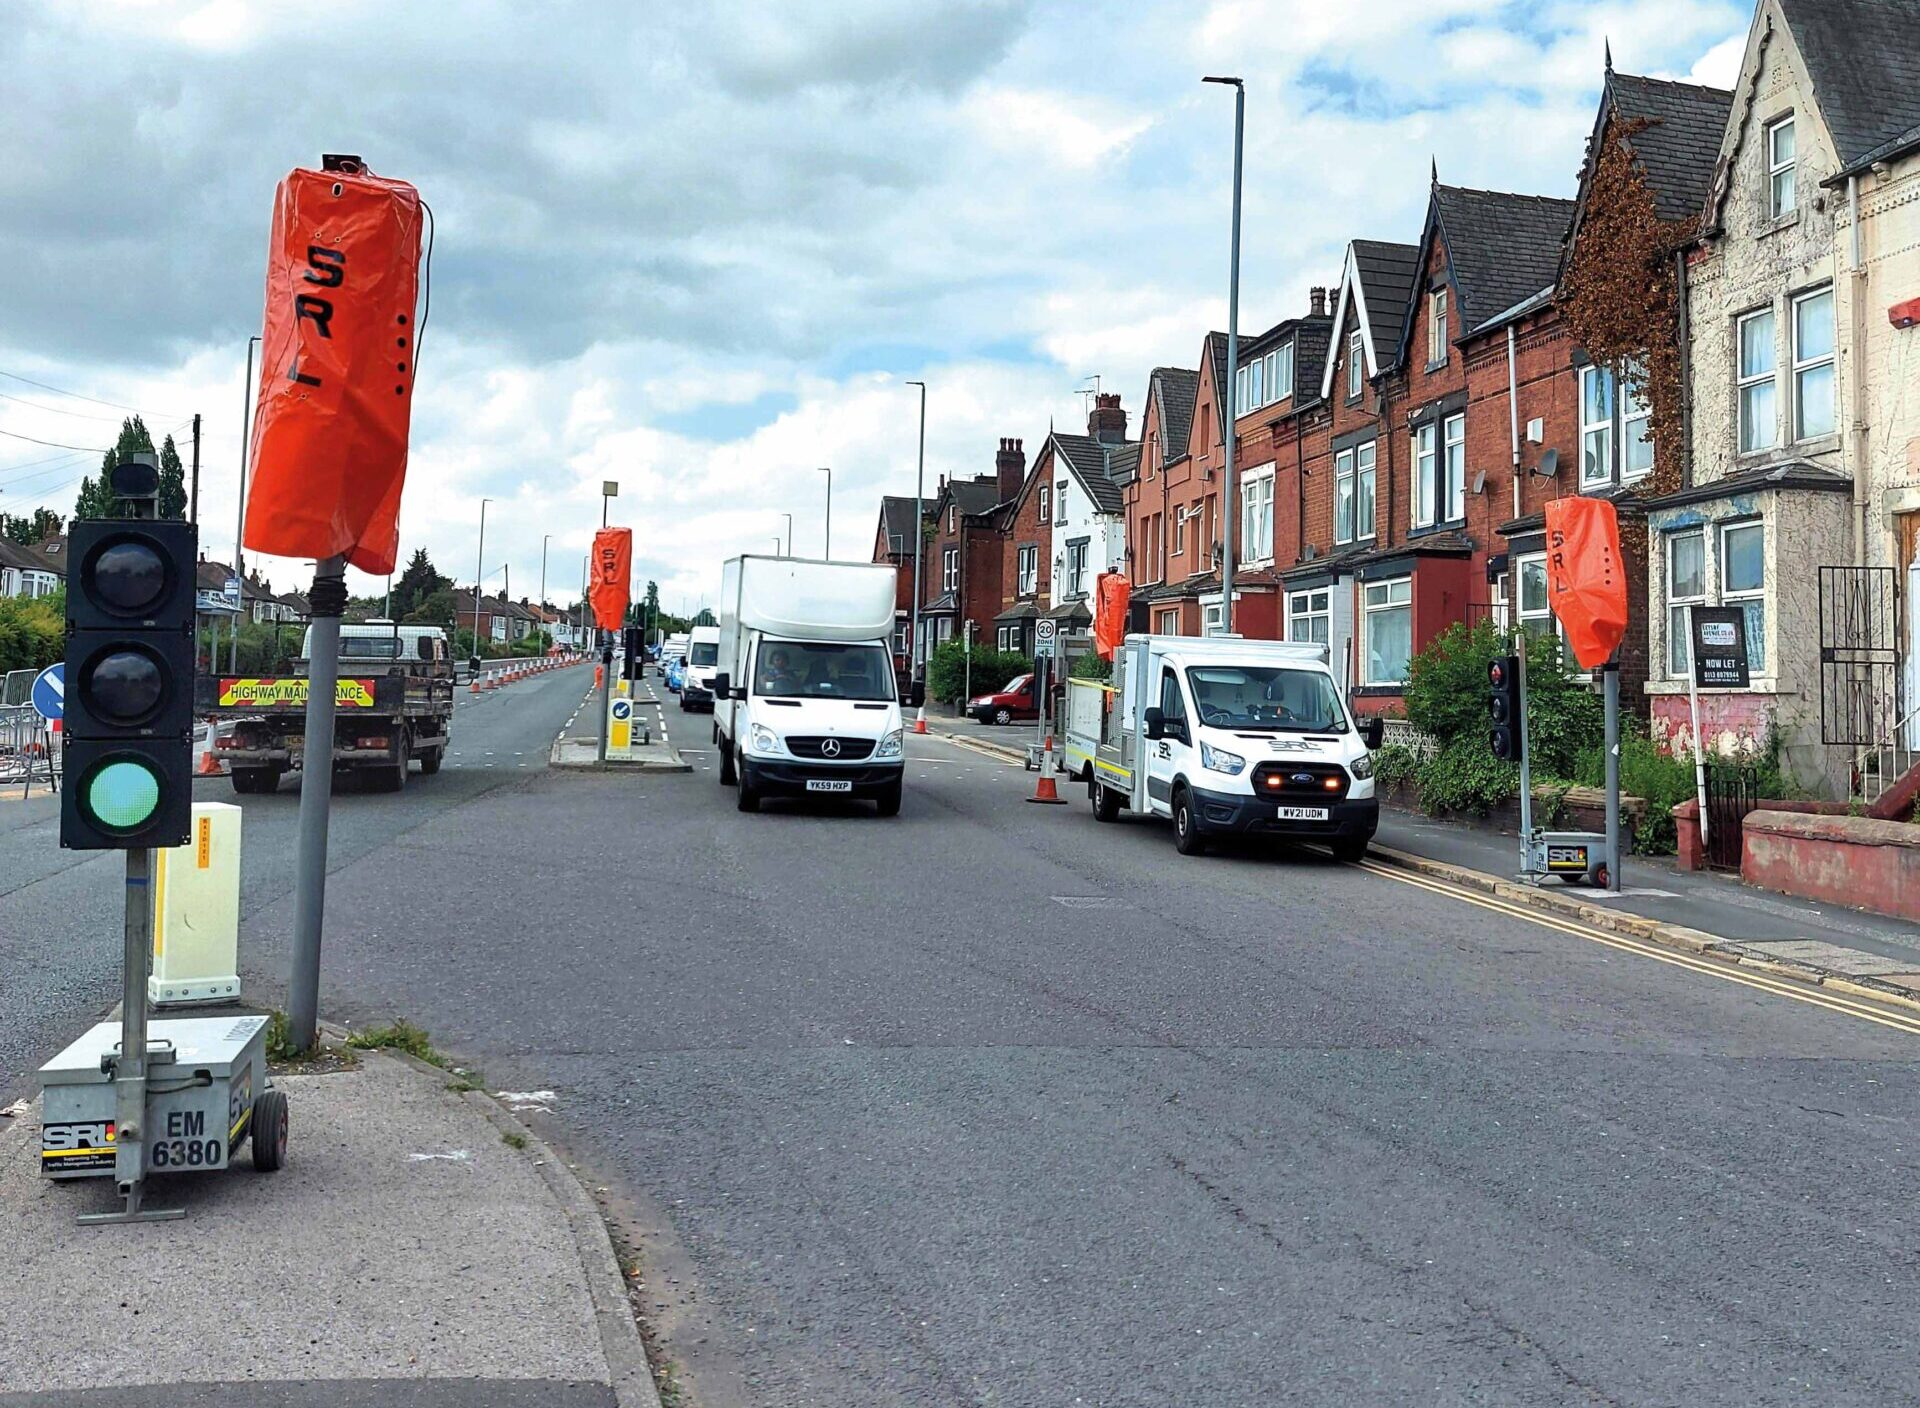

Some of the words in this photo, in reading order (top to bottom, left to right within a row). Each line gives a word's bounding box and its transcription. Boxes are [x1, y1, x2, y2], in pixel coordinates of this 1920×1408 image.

[602, 548, 617, 585] SRL
[1551, 530, 1569, 593] SRL
[1039, 625, 1052, 634] 20
[1705, 658, 1722, 669] NOW
[1723, 658, 1736, 669] LET
[230, 686, 282, 699] HIGHWAY
[810, 781, 832, 790] YK59
[832, 782, 849, 790] HXP
[1283, 808, 1304, 818] WV21
[1305, 809, 1323, 819] UDM
[167, 1109, 205, 1138] EM
[42, 1123, 117, 1150] SRL
[152, 1139, 222, 1168] 6380
